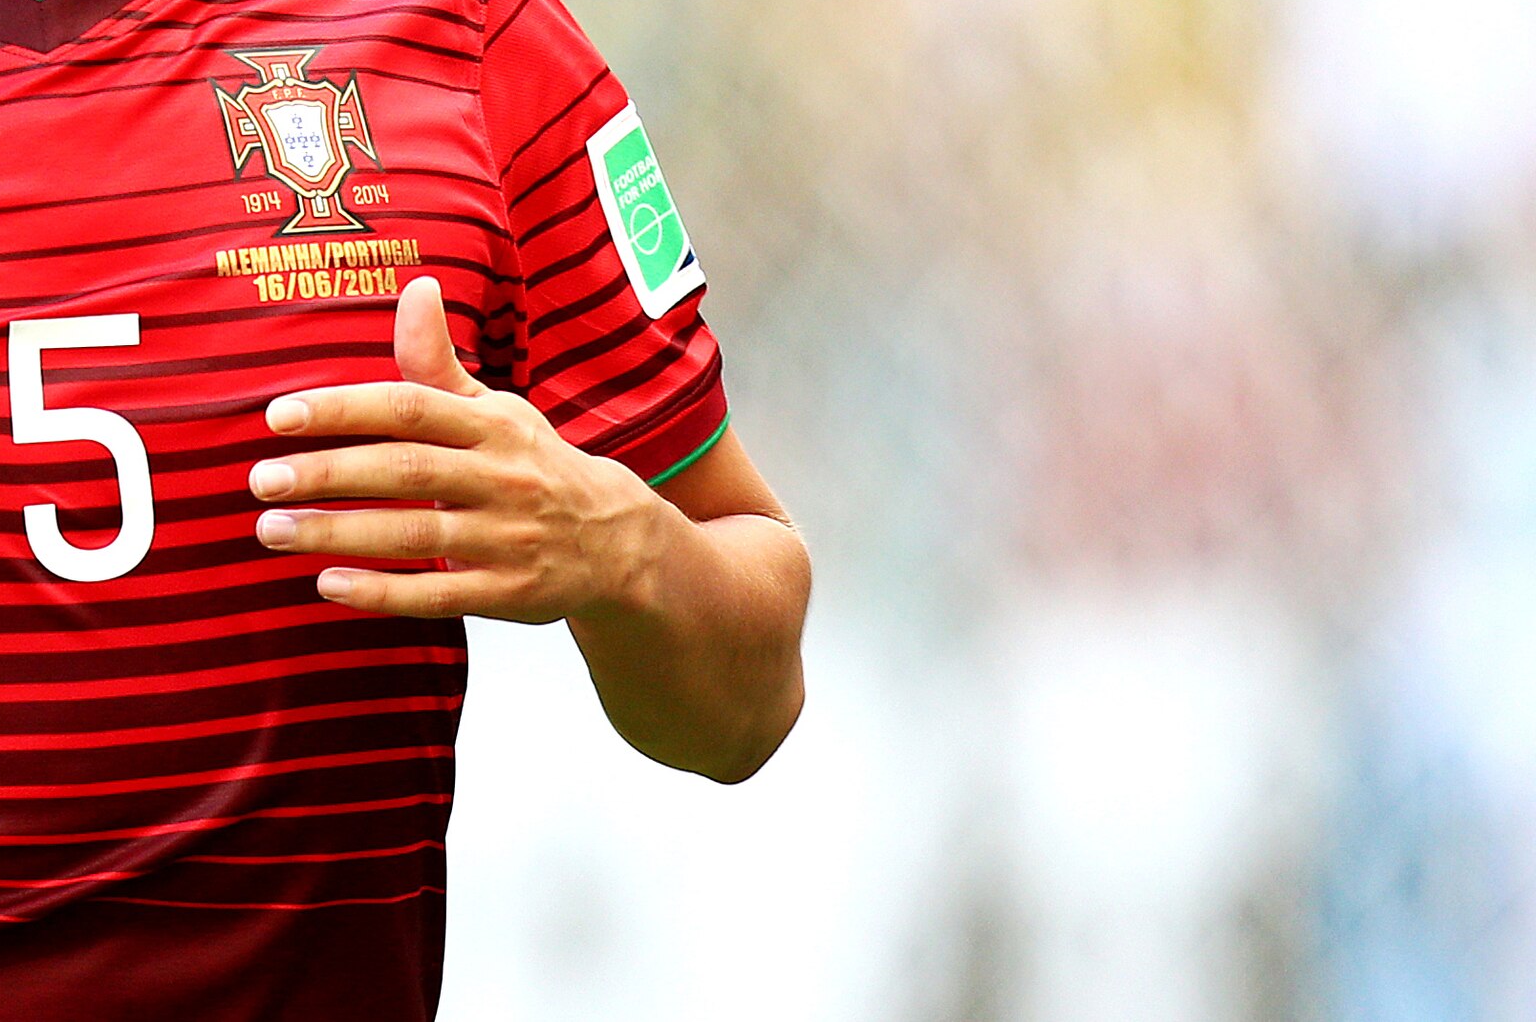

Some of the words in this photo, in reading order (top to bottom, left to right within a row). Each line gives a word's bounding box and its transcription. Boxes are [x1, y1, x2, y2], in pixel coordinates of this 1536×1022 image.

[613, 155, 657, 194] FOOTBA
[241, 190, 282, 214] 1914
[352, 184, 389, 206] 2014
[618, 185, 641, 209] FOR
[253, 267, 399, 302] 16/06/2014
[8, 313, 155, 582] 5
